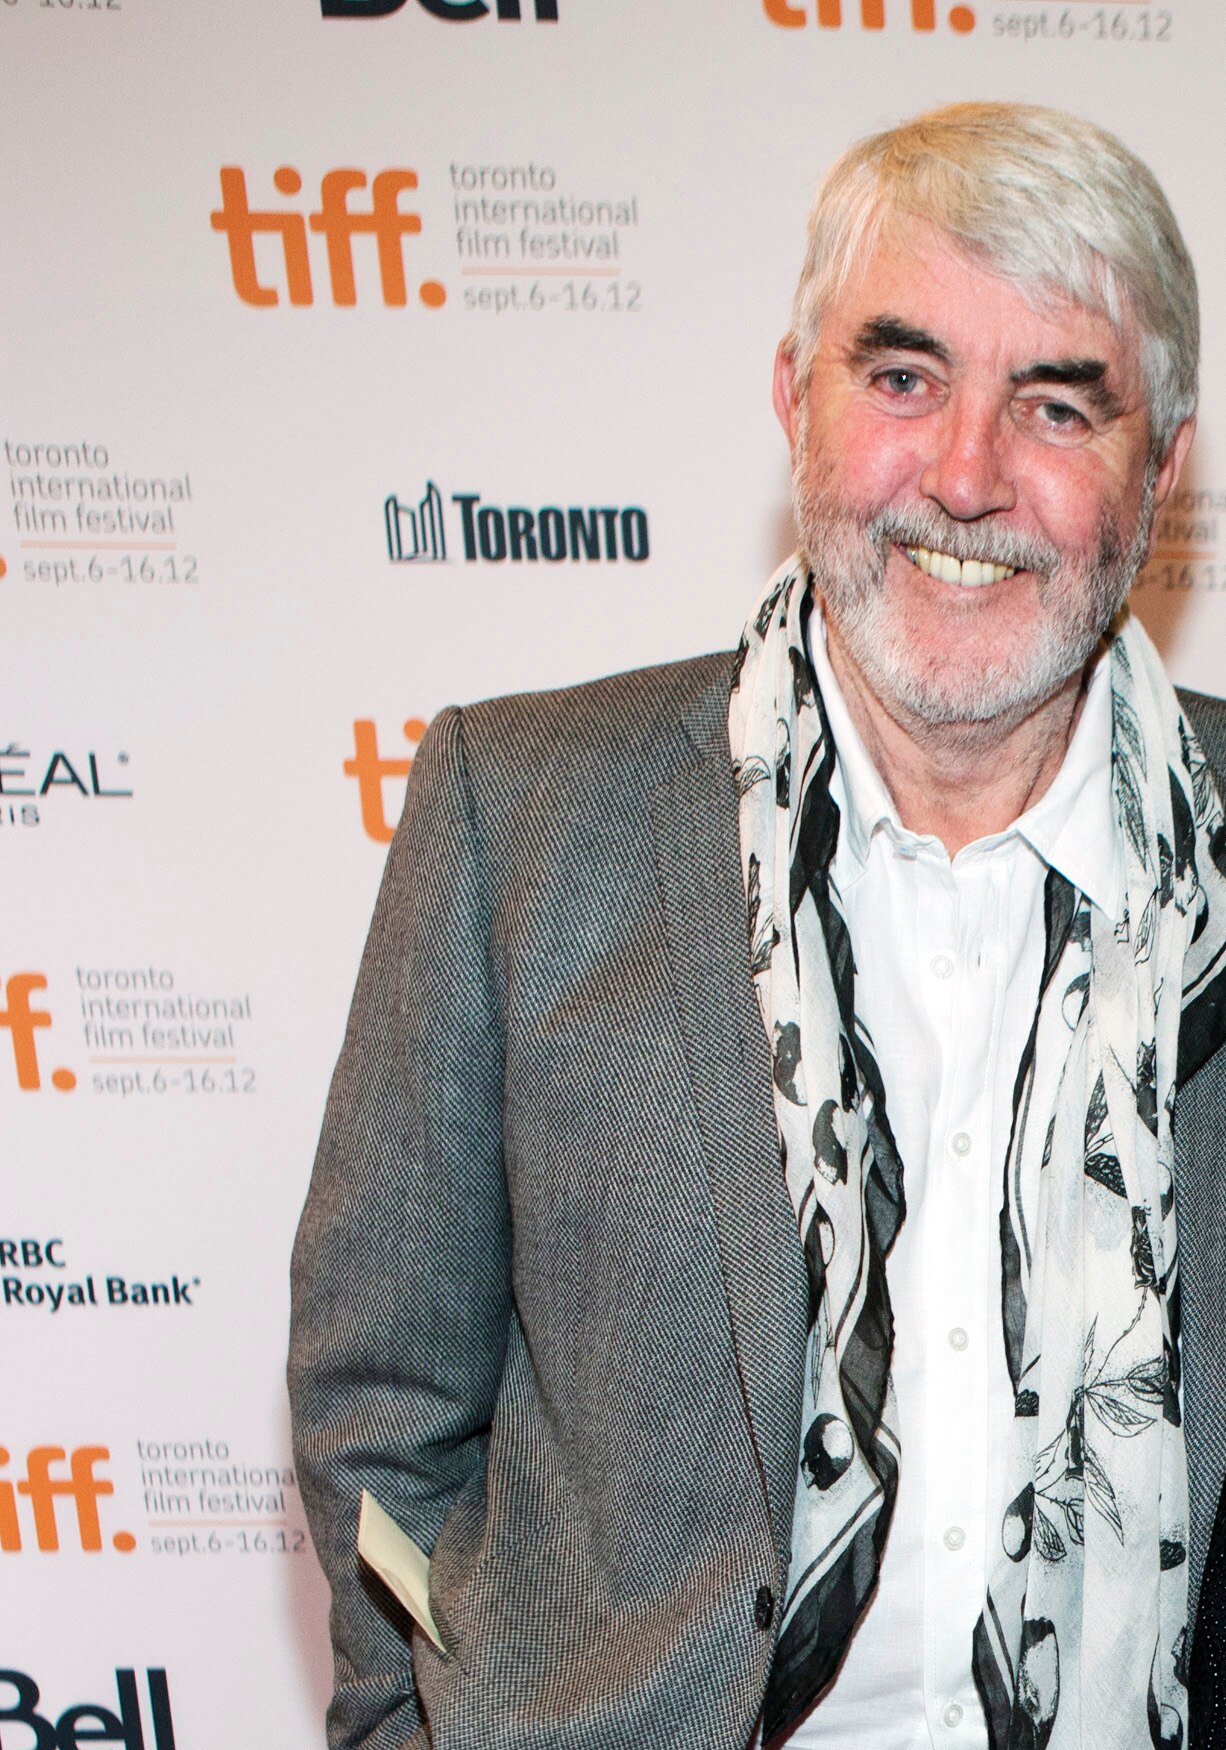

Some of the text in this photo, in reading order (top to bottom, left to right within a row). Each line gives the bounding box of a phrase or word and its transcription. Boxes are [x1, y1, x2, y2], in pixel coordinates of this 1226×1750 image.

[450, 161, 556, 190] toronto
[454, 196, 638, 226] international
[456, 229, 619, 259] film festival
[463, 281, 642, 314] sept.6-16.12
[4, 440, 109, 468] toronto
[10, 473, 192, 501] international
[14, 503, 174, 533] film festival
[452, 493, 649, 563] TORONTO
[24, 556, 198, 586] sept.6-16.12
[76, 966, 173, 990] toronto
[81, 994, 251, 1021] international
[84, 1023, 234, 1050] film festival
[0, 1240, 66, 1267] RBC
[3, 1277, 96, 1312] Royal
[137, 1439, 229, 1461] toronto
[141, 1464, 296, 1488] internationa
[144, 1489, 285, 1513] film festival
